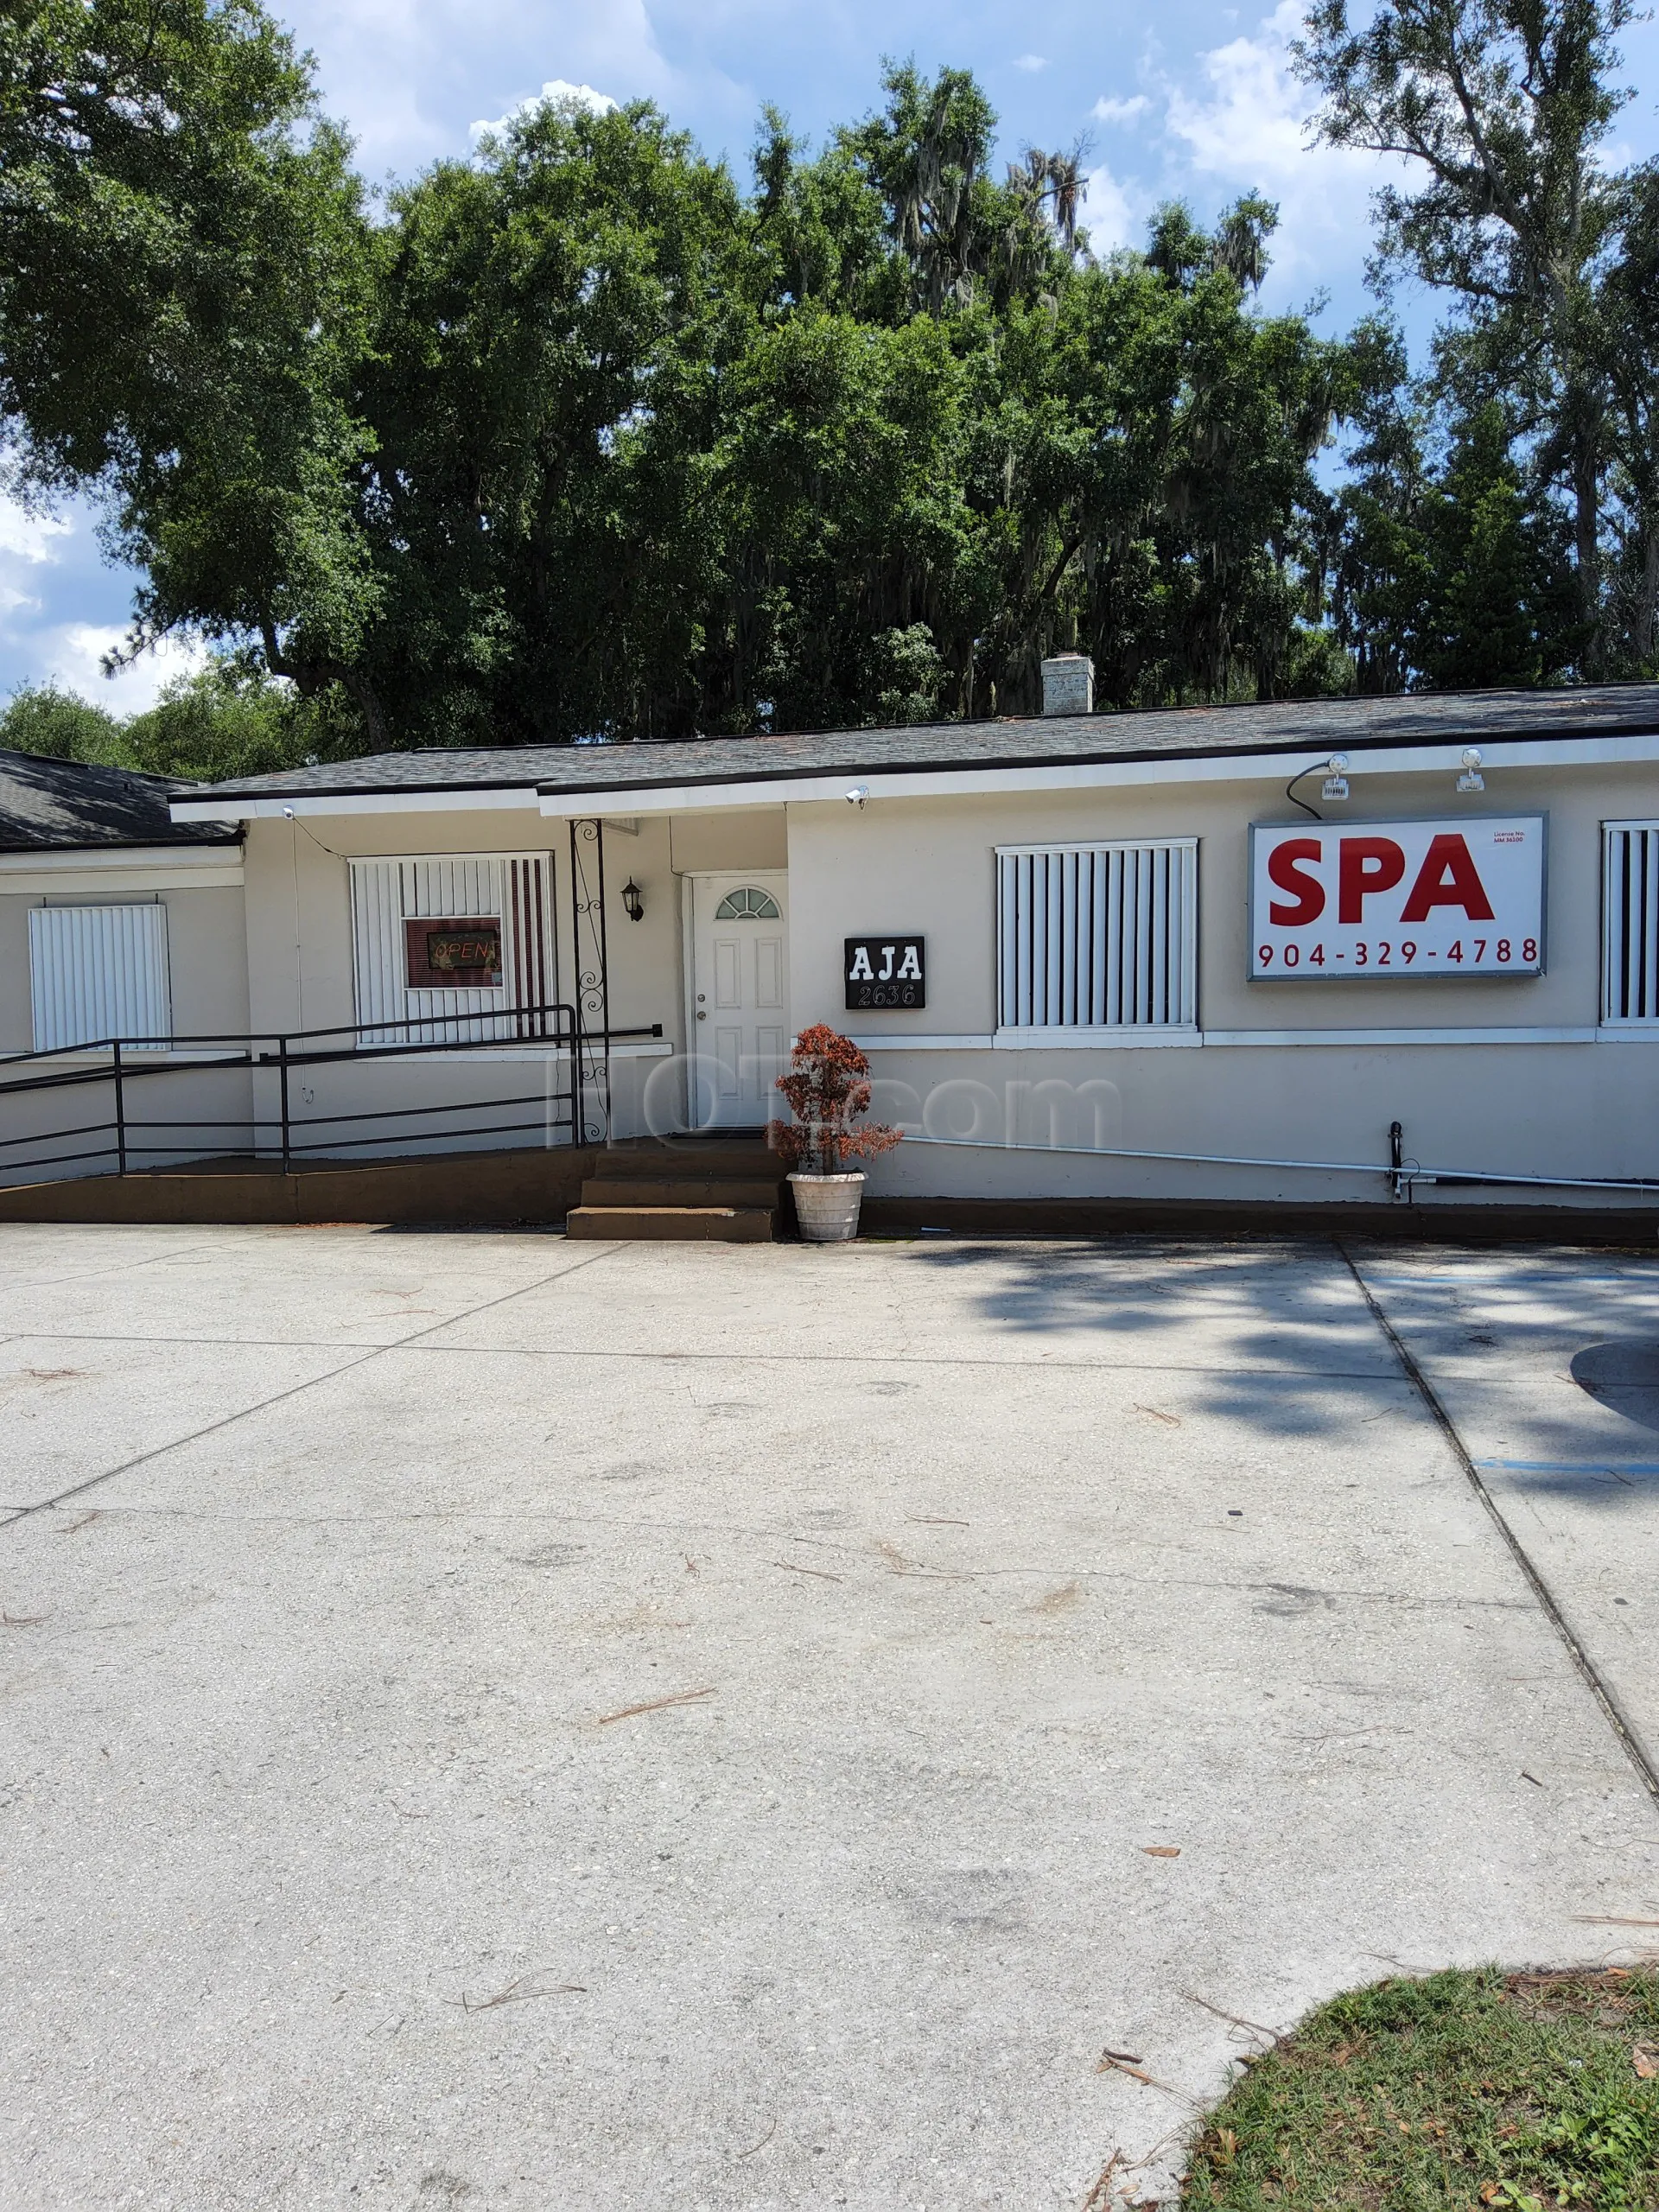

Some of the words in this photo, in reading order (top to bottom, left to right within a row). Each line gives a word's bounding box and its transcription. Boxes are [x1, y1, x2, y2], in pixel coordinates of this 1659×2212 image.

[1268, 833, 1496, 926] SPA
[435, 941, 489, 959] OPEN
[849, 946, 923, 981] AJA
[1258, 938, 1538, 969] 904-329-4788
[858, 983, 916, 1006] 2636
